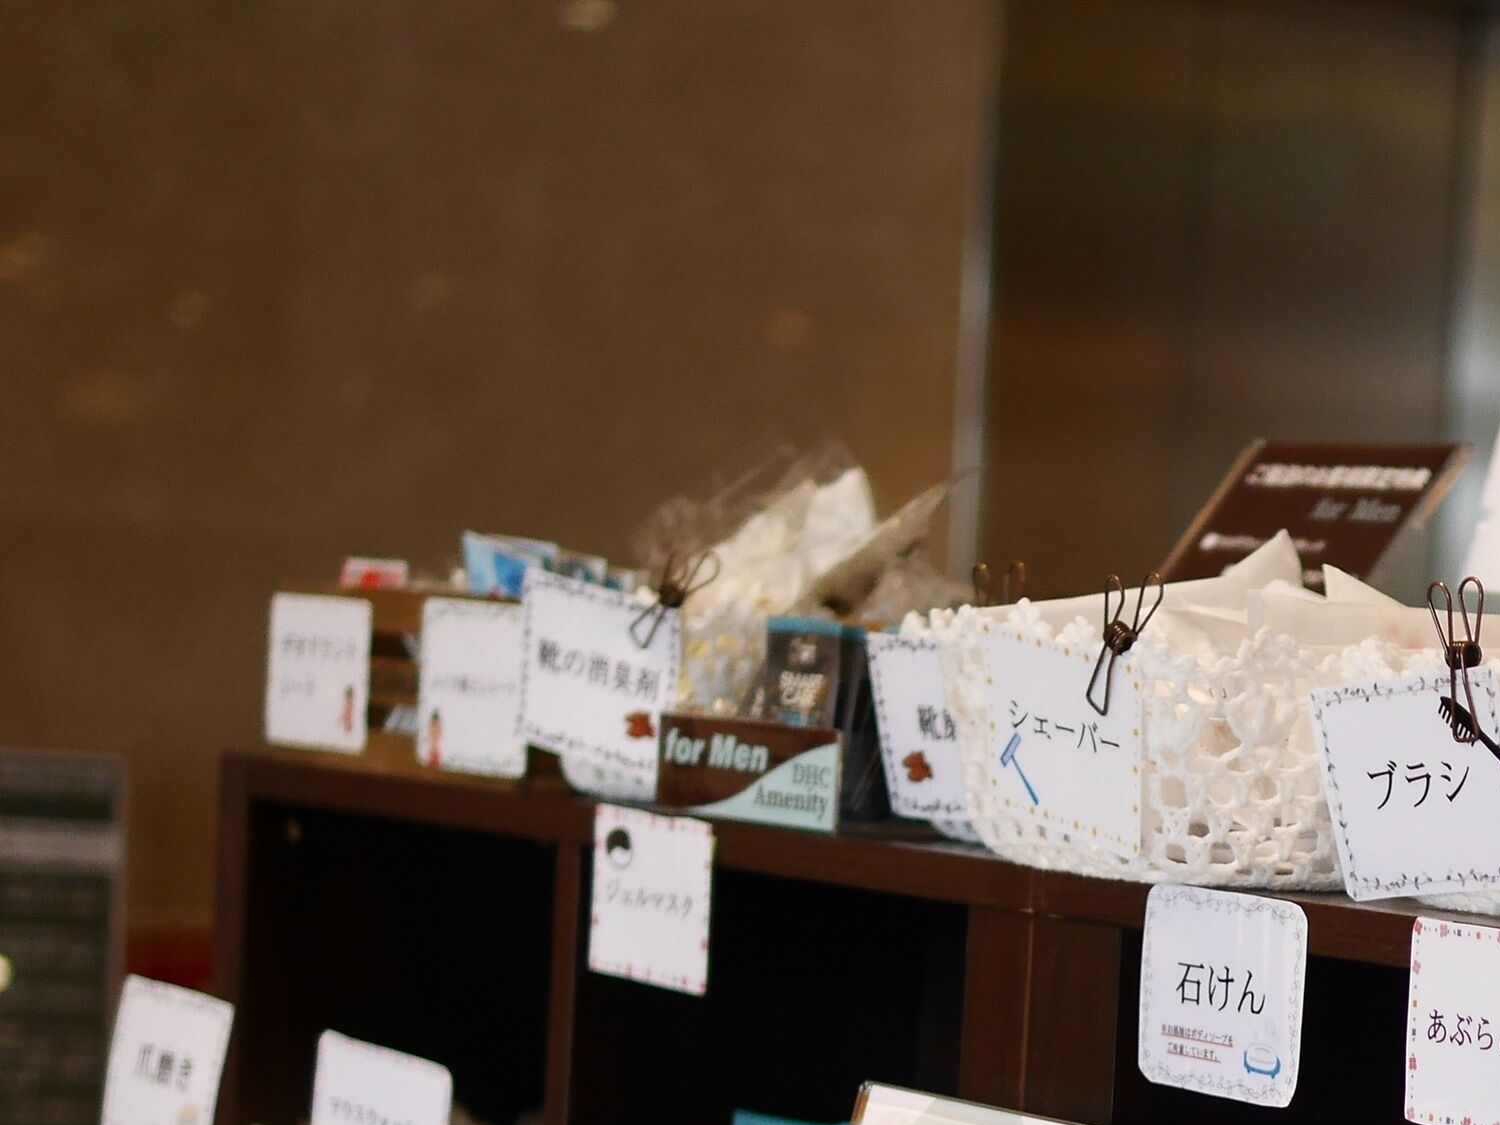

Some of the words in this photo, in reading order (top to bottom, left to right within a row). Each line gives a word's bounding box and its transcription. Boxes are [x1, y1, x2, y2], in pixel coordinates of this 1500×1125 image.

[537, 639, 661, 701] 靴の消臭剤
[665, 727, 705, 765] for
[708, 733, 769, 773] Men
[1009, 701, 1120, 753] シェーバー
[793, 762, 830, 789] DHC
[1366, 760, 1471, 811] ブラシ
[754, 787, 829, 820] Amenity
[1175, 961, 1266, 1015] 石けん
